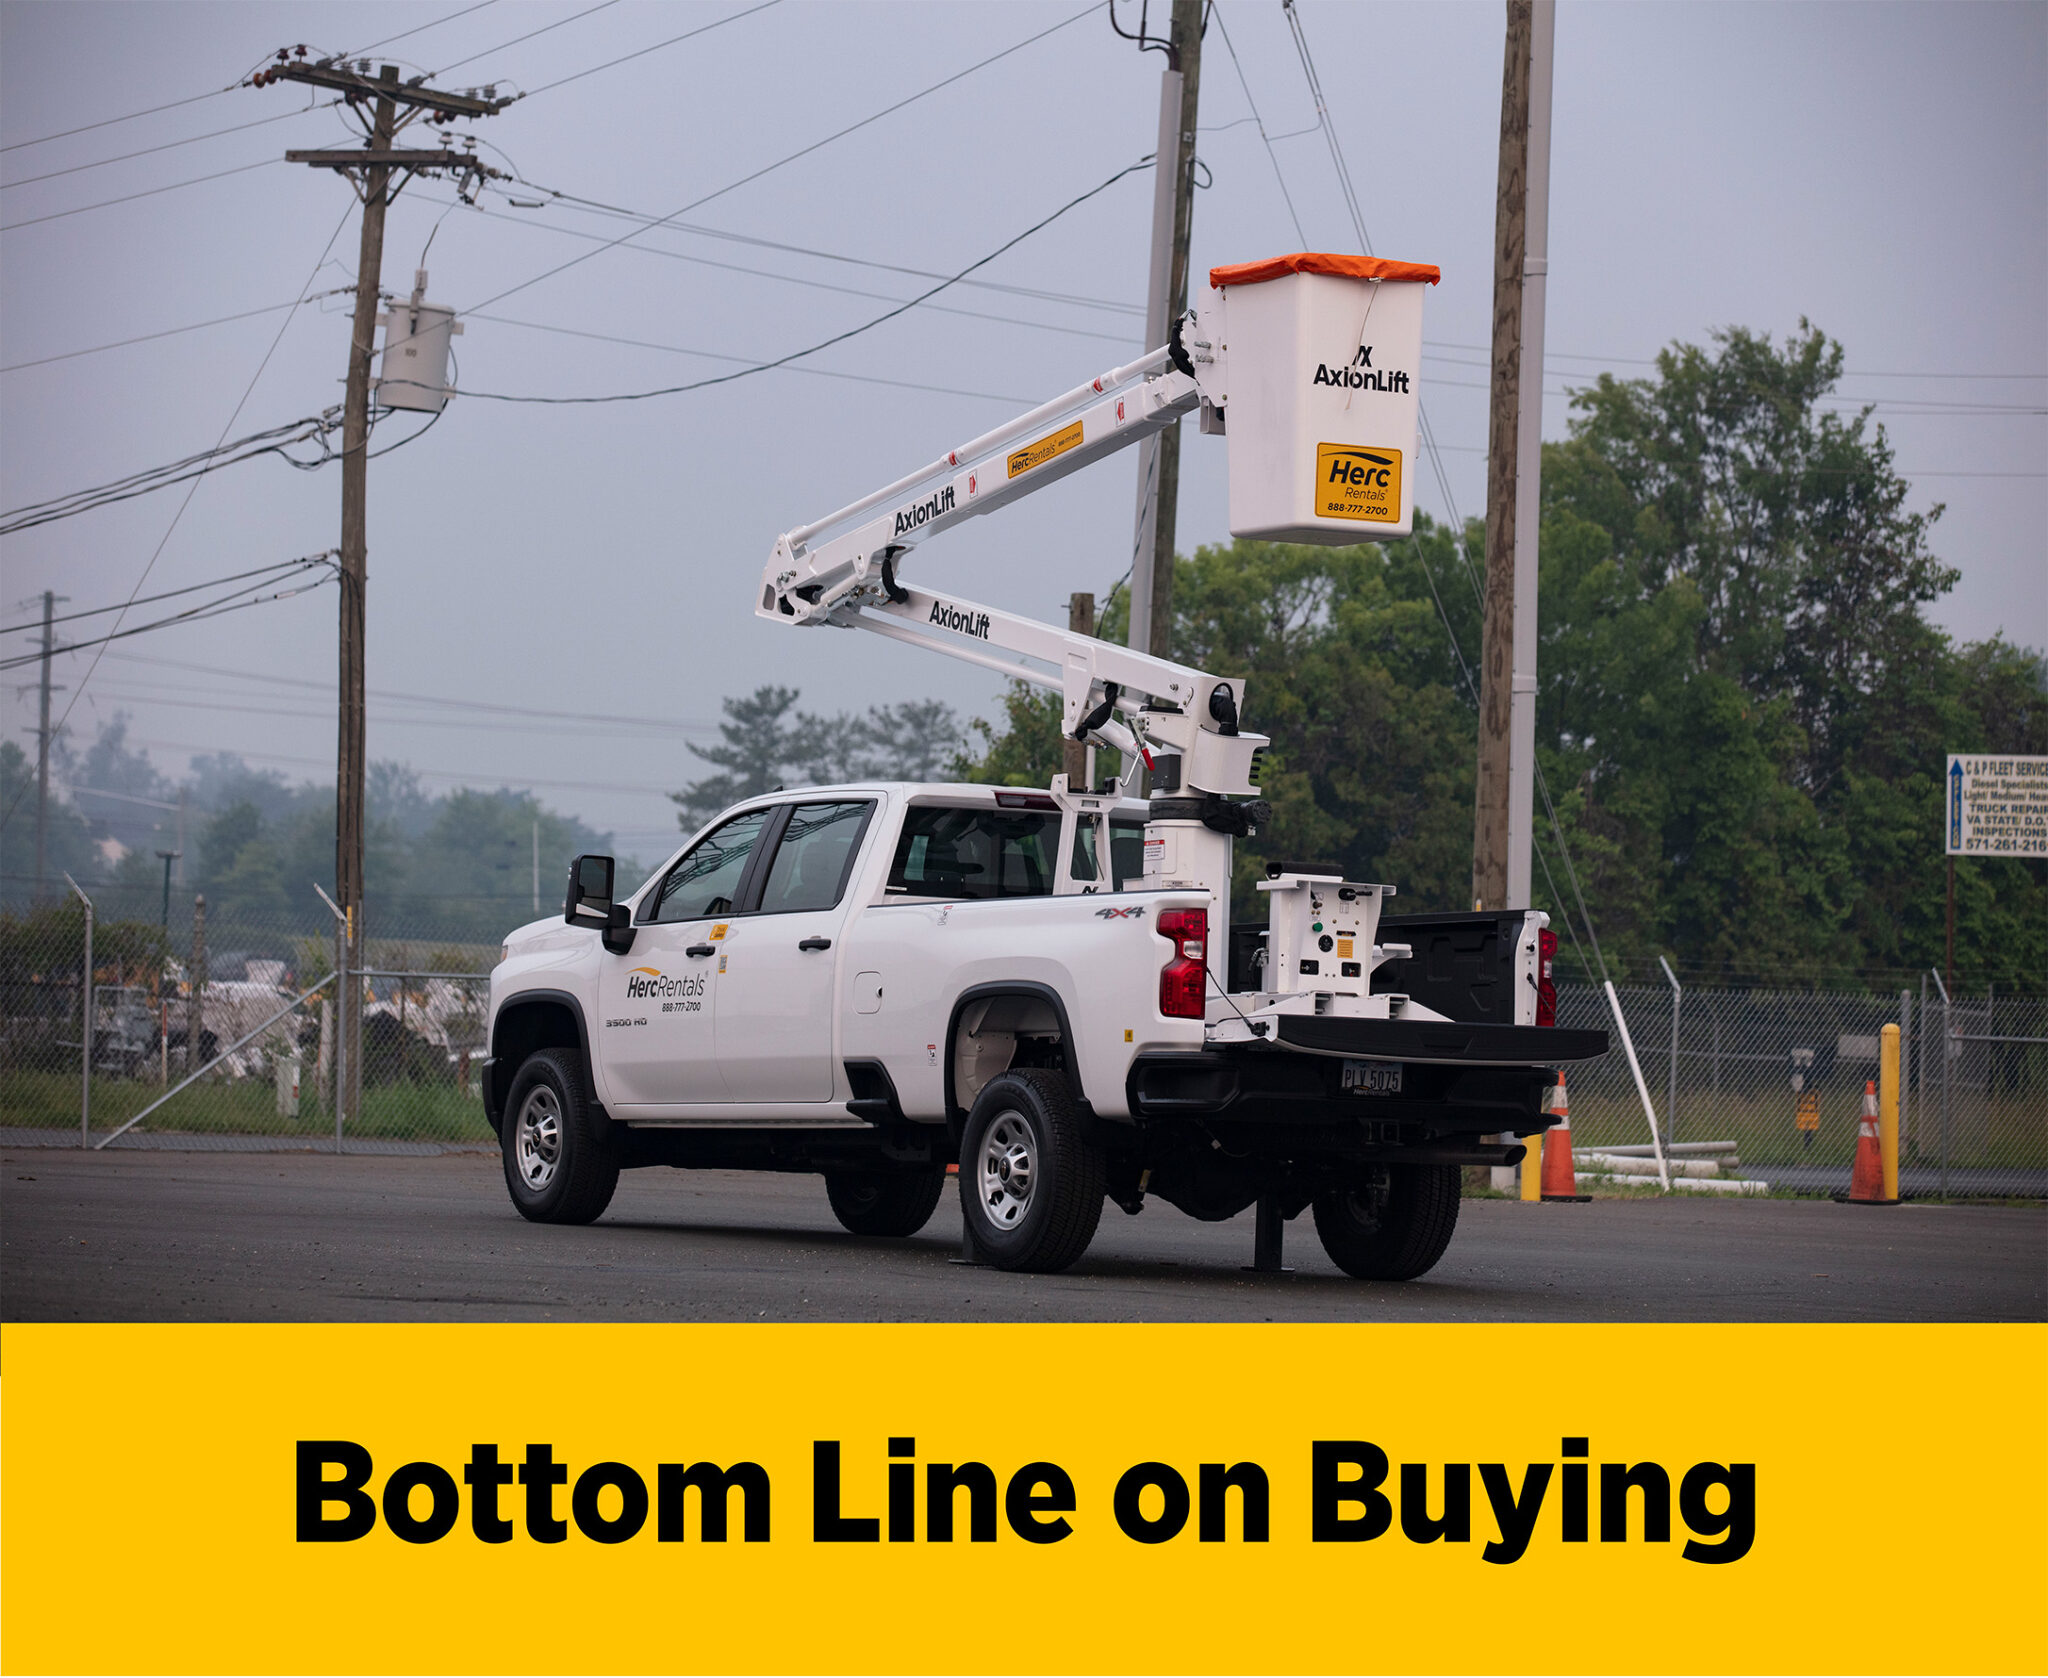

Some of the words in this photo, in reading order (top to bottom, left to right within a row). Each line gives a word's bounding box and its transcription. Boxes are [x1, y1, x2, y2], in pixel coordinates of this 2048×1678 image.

[1313, 363, 1410, 395] AxionLift
[1328, 459, 1392, 488] Herc
[1344, 486, 1386, 501] Rentals
[894, 485, 957, 537] AxionLift
[1327, 502, 1389, 516] 888-777-2700
[928, 600, 990, 641] AxionLift
[1989, 761, 2014, 776] FLEET
[1969, 803, 2008, 814] TRUCK
[1967, 815, 1981, 825] VA
[1972, 826, 2048, 838] INSPECTIONS
[661, 1001, 701, 1012] 888-777-2700
[1370, 1070, 1400, 1090] 5075
